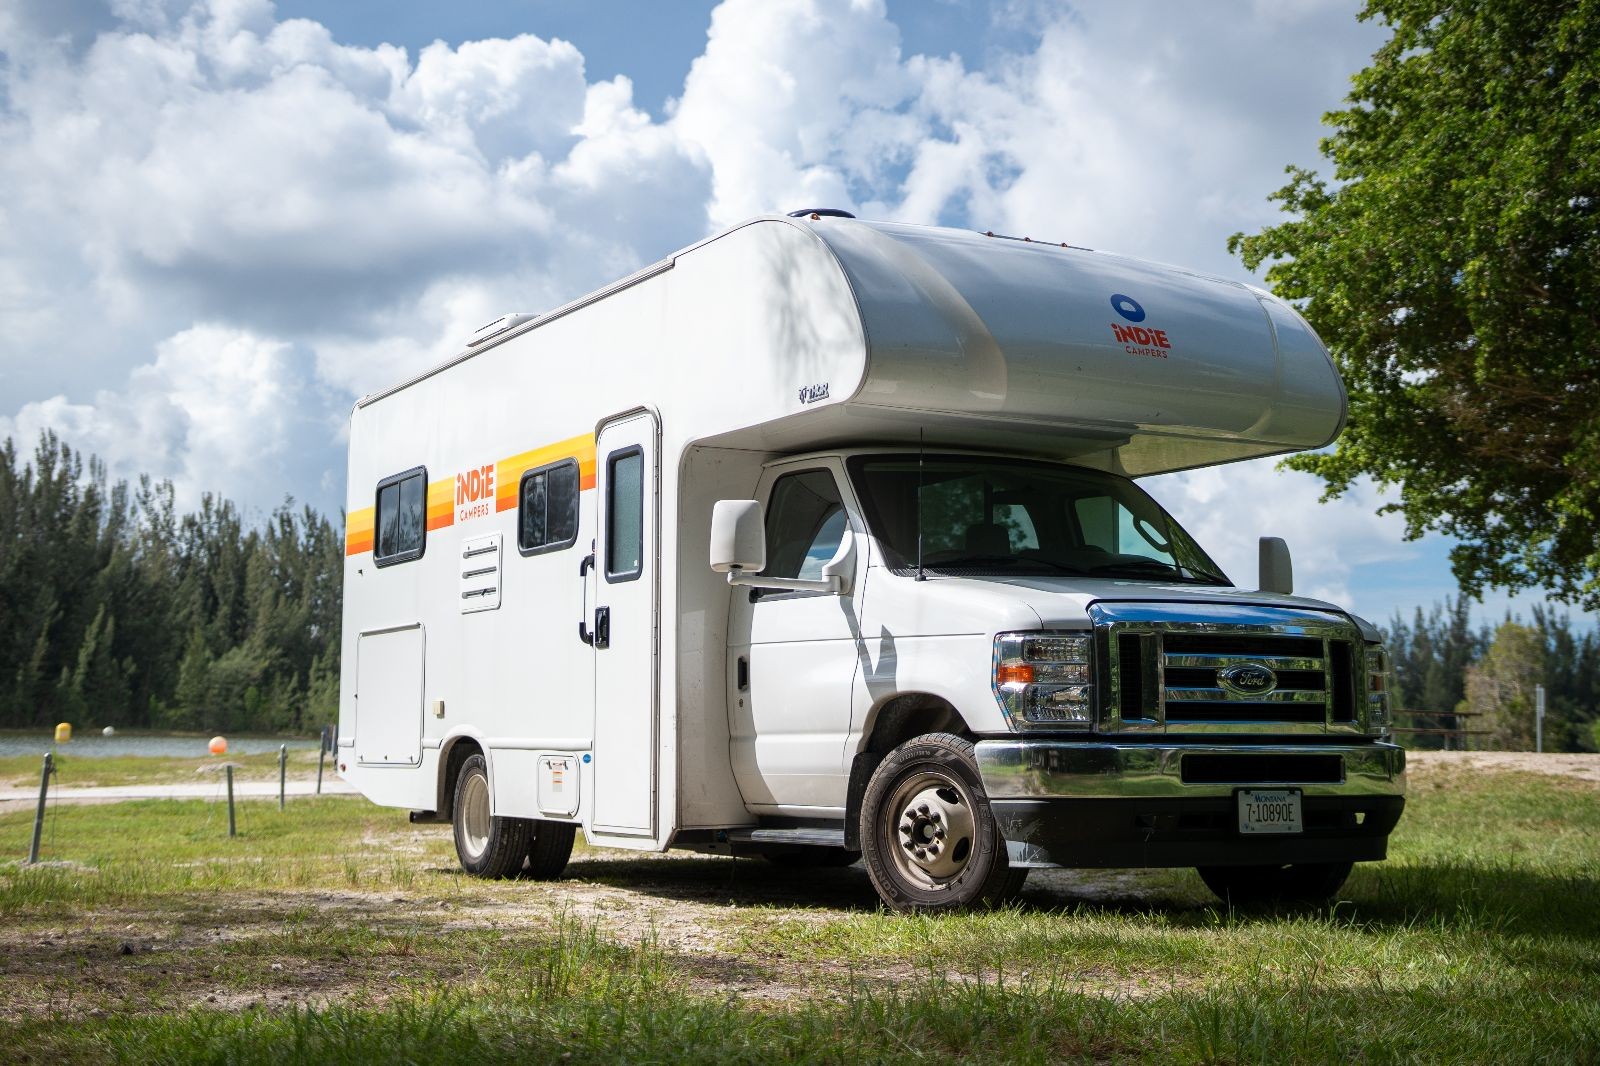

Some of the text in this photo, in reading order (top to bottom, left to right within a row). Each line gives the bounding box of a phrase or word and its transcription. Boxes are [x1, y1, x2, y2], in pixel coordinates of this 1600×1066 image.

[1111, 323, 1171, 348] iNDiE
[1125, 346, 1168, 359] CAMPERS
[456, 464, 493, 505] iNDiE
[460, 503, 488, 521] CAMPERS
[1240, 671, 1264, 685] Ford
